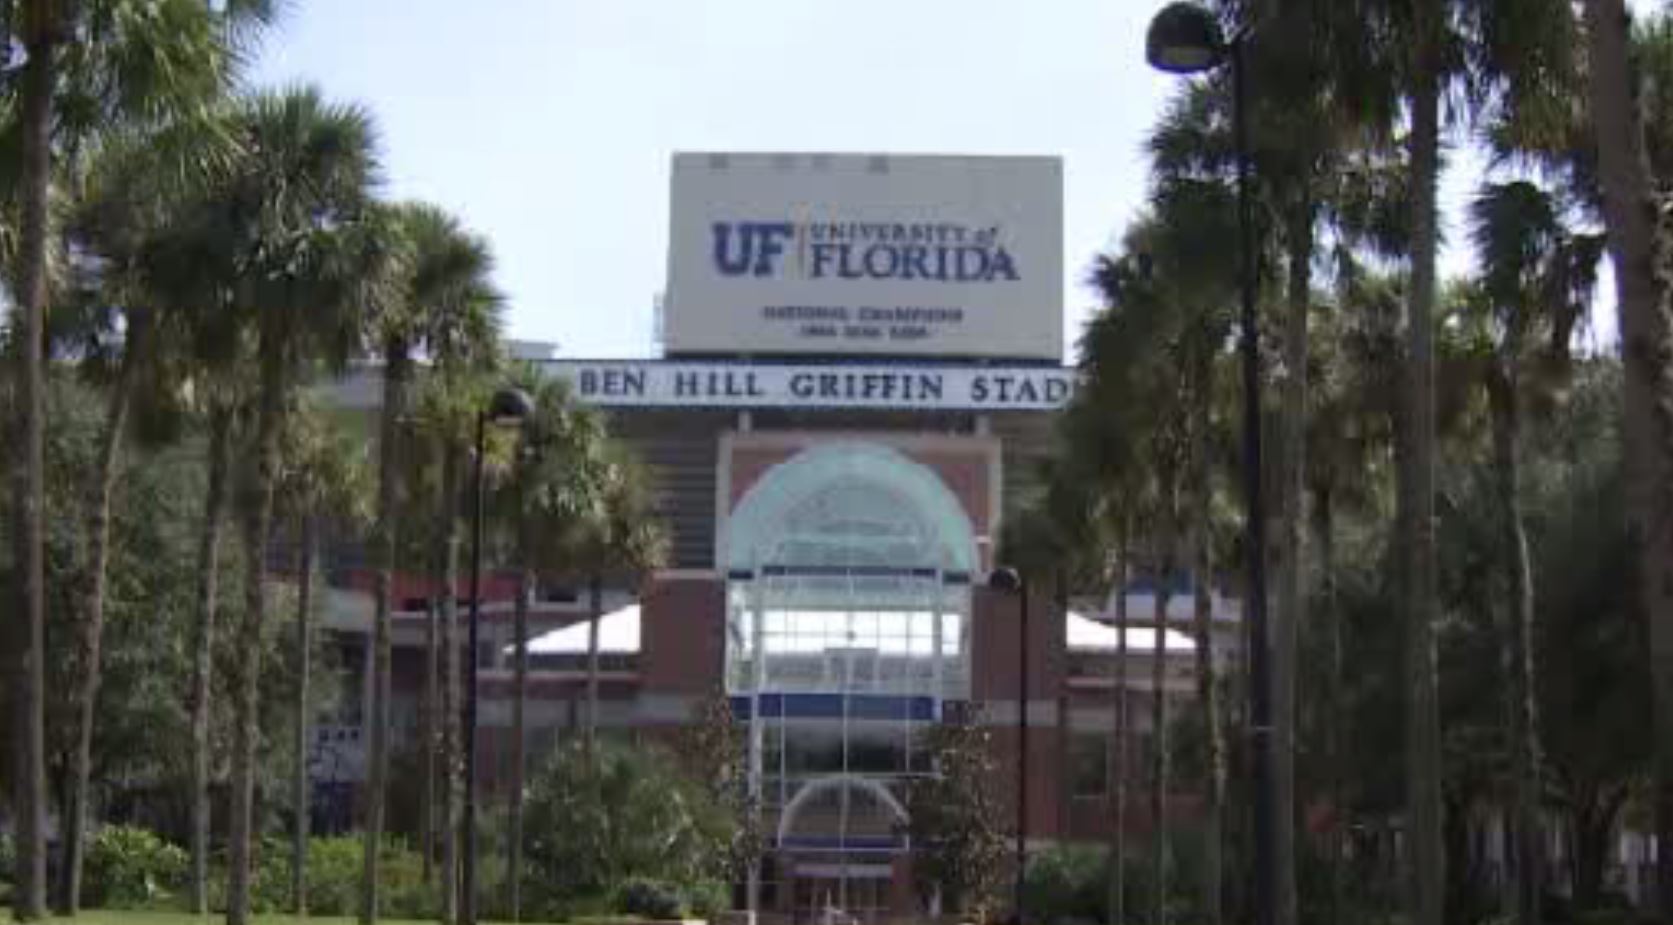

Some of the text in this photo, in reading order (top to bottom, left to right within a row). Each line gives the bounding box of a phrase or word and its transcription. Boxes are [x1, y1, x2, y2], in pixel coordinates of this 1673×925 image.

[712, 221, 794, 276] UF
[810, 222, 999, 246] UNIVERSITY of
[810, 243, 1021, 282] FLORIDA
[579, 368, 1069, 403] BEN HILL GRIFFIN STAD
